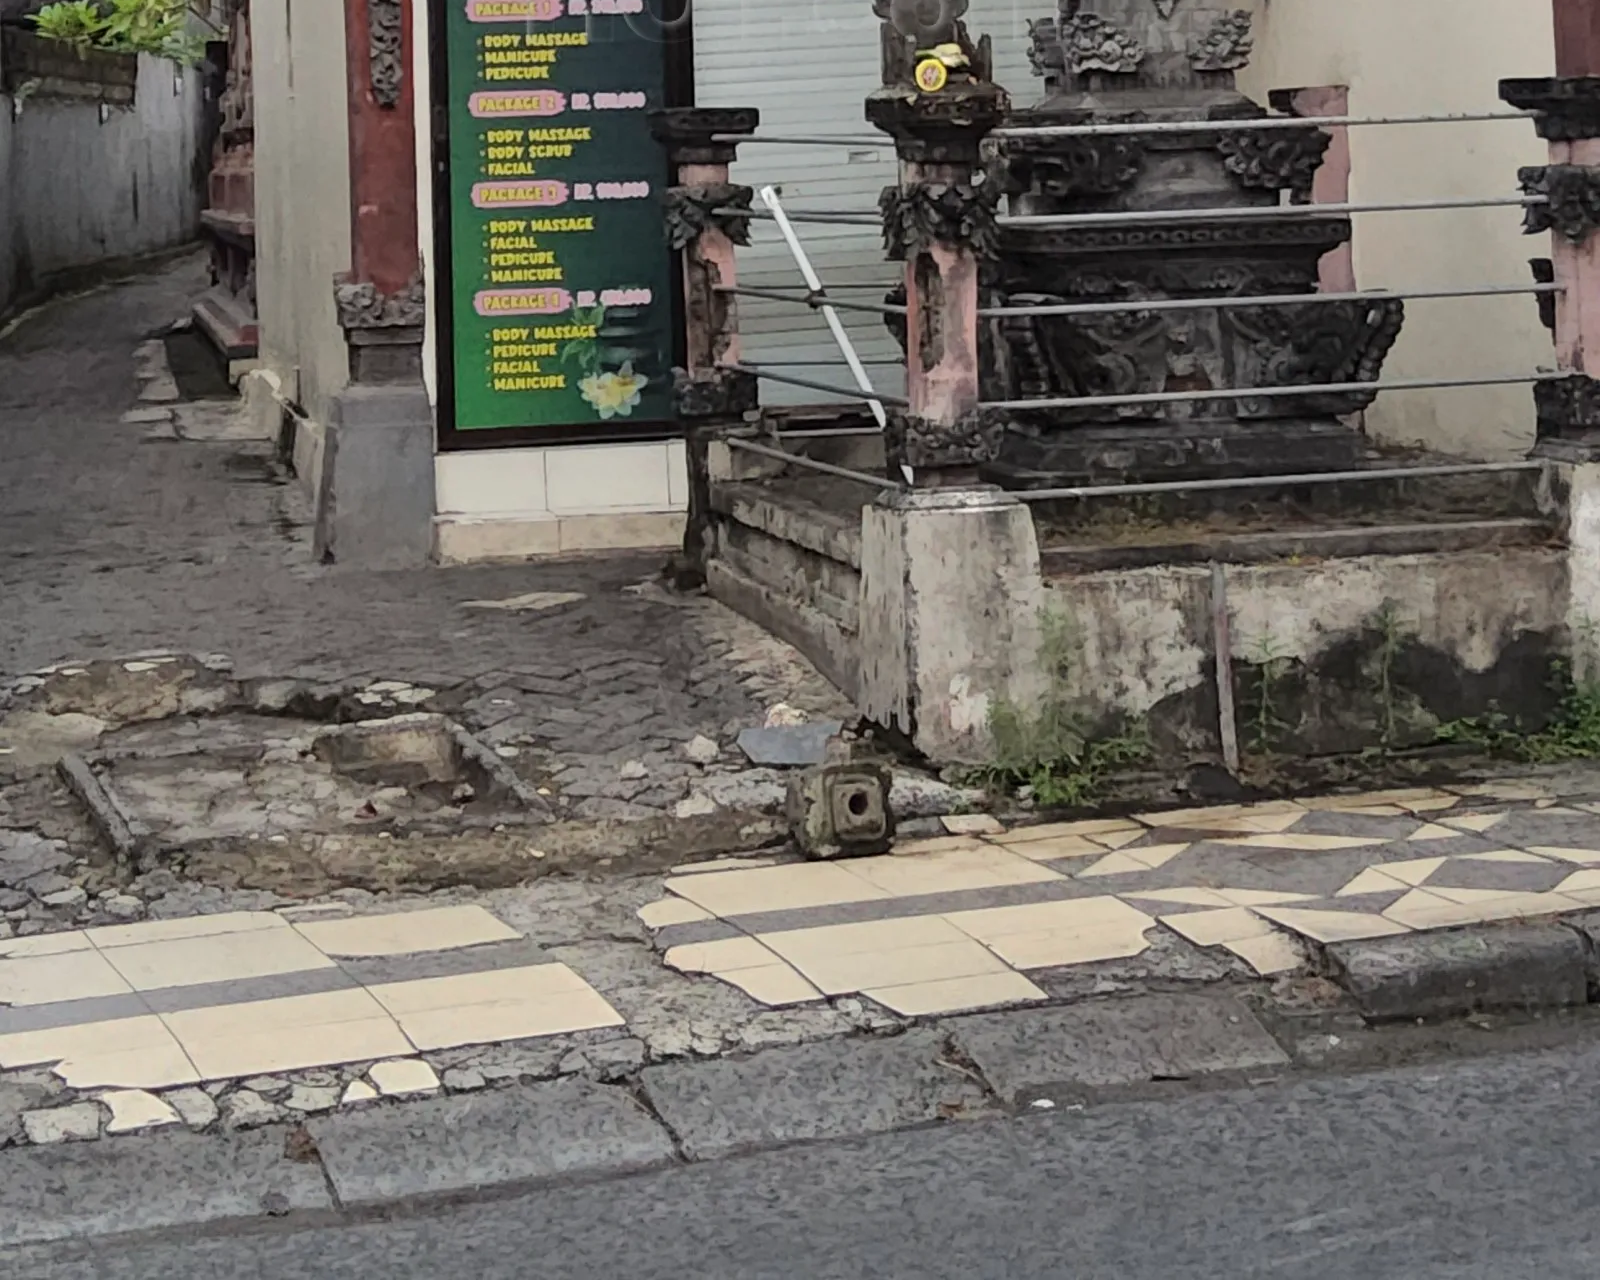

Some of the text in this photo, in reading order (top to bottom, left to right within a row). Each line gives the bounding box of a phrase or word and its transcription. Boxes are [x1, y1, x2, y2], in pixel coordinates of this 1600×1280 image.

[475, 2, 538, 16] PACKAGE
[484, 32, 588, 48] BODY MASSAGE
[484, 49, 557, 63] MANICURE
[485, 66, 549, 80] PEDICURE
[478, 97, 541, 111] PACKAGE
[487, 127, 592, 143] BODY MASSAGE
[487, 144, 573, 159] BODY SCRUB
[488, 161, 535, 175] FACIAL
[480, 188, 543, 202] PACKAGE
[490, 217, 594, 234] BODY MASSAGE
[490, 237, 537, 250] FACIAL
[490, 252, 555, 266] PEDICURE
[491, 268, 563, 283] MANICURE
[483, 295, 546, 310] PACKAGE
[492, 325, 598, 342] BODY MASSAGE
[493, 343, 557, 358] PEDICURE
[493, 361, 540, 374] FACIAL
[494, 375, 566, 391] MANICURE
